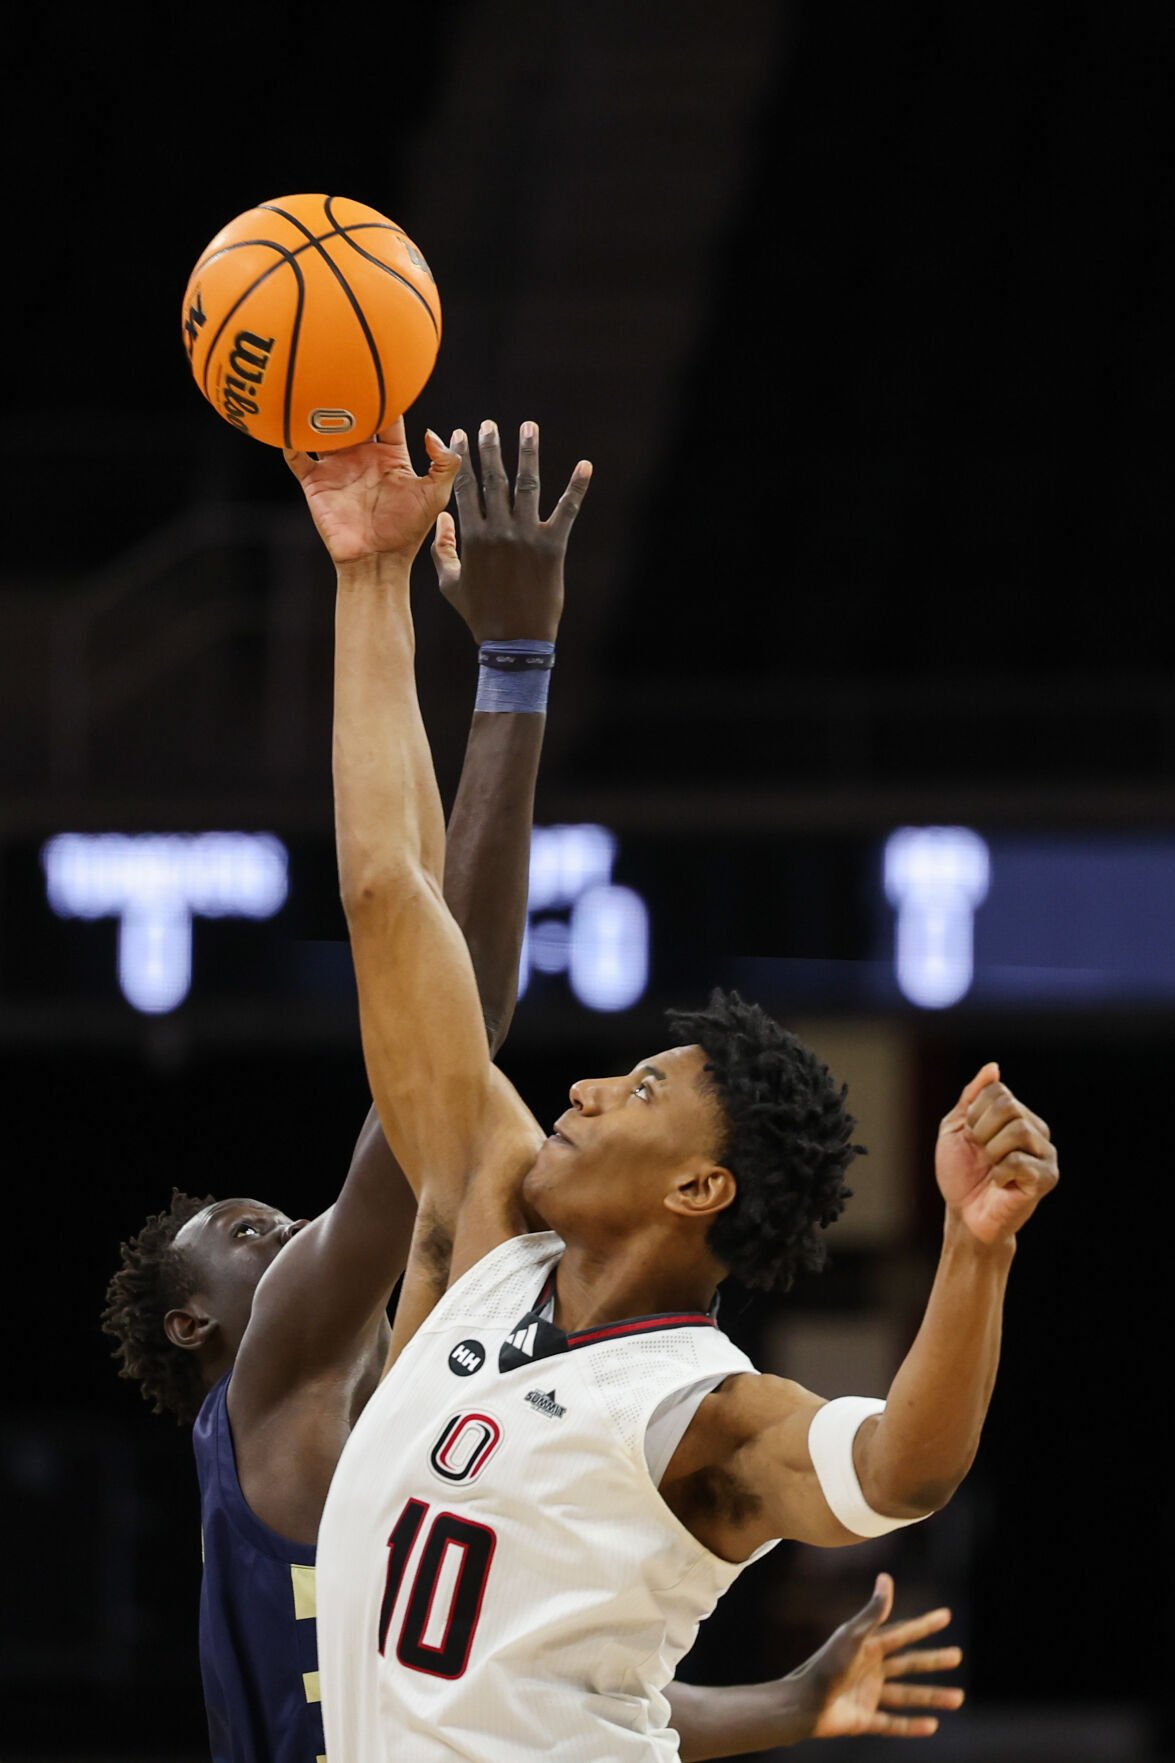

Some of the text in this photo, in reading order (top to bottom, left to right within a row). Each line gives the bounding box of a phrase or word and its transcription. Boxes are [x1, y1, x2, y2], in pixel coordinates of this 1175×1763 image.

[223, 330, 275, 433] Wilso
[451, 1344, 481, 1372] HH
[524, 1391, 567, 1419] SUMMIT
[378, 1496, 498, 1681] 10
